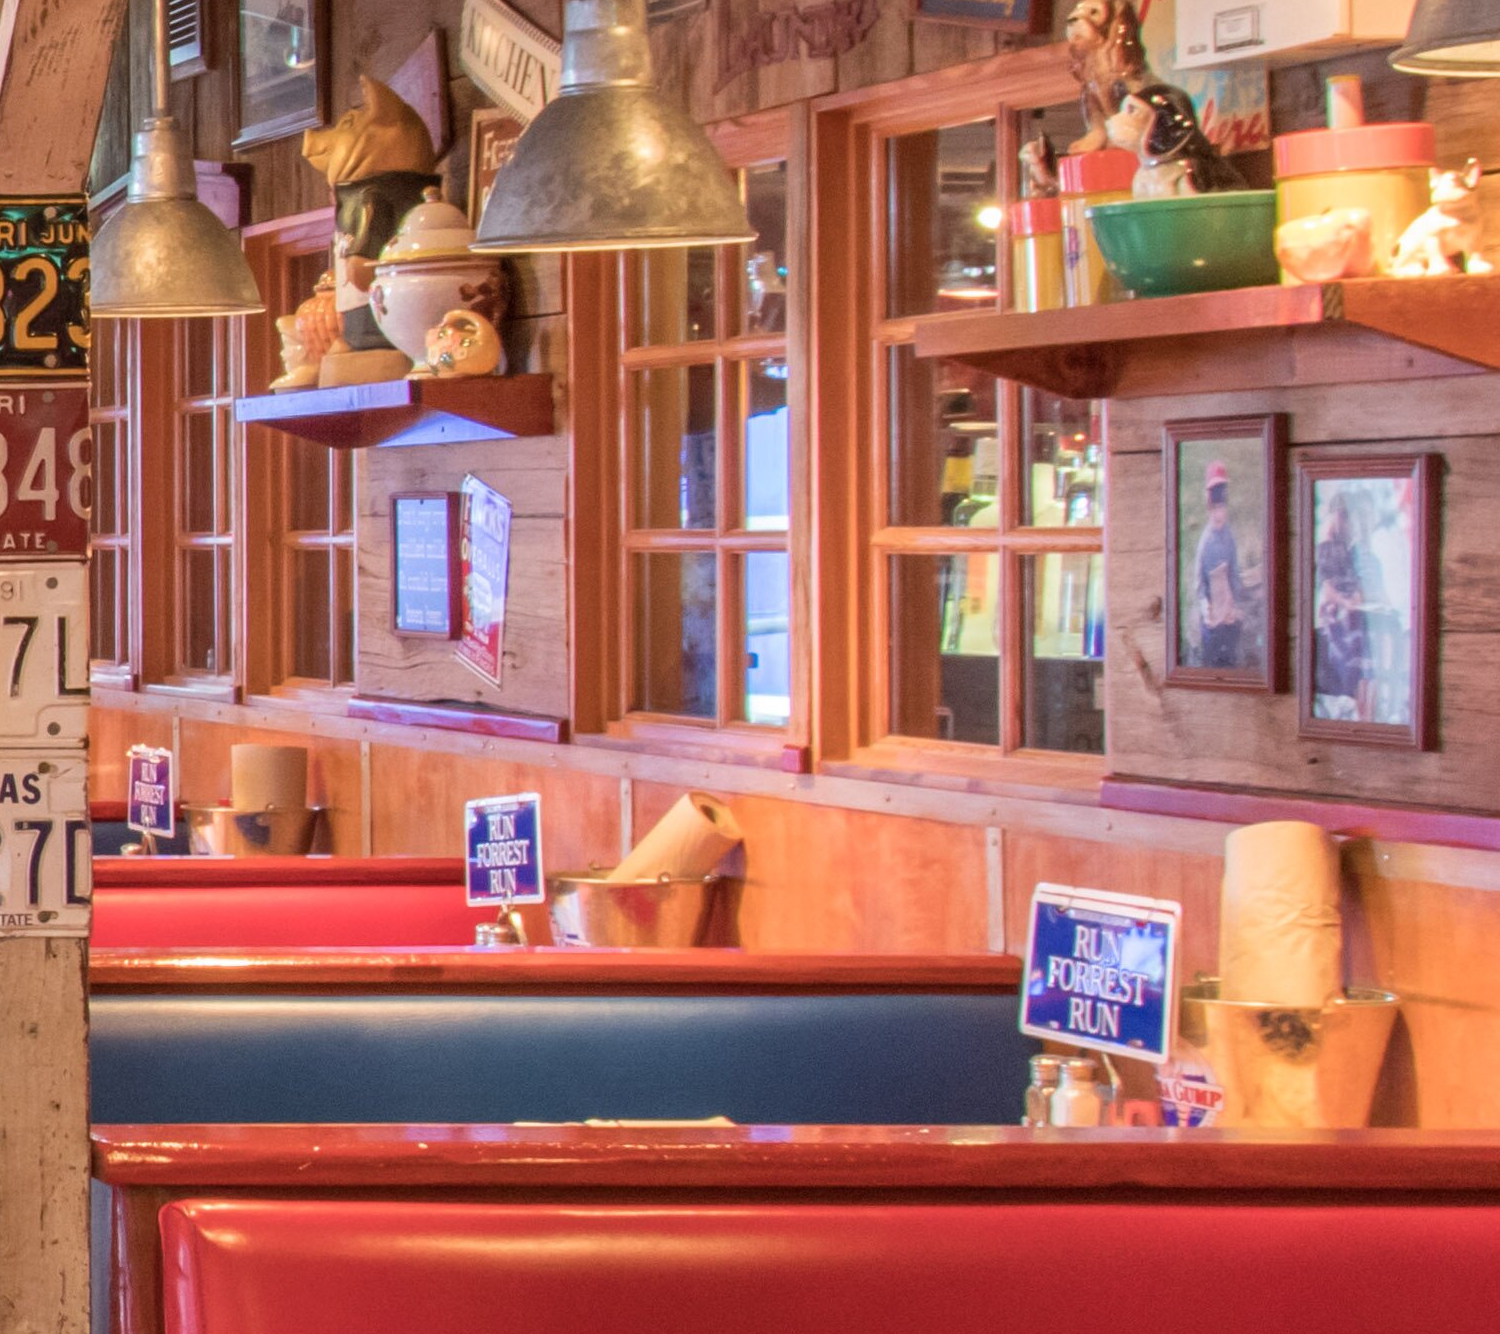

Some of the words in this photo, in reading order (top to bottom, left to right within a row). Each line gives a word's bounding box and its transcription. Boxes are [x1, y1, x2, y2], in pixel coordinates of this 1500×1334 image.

[490, 815, 516, 840] RUN
[477, 840, 529, 867] FORREST
[490, 869, 516, 895] RUN
[1074, 925, 1122, 961] RUN
[1047, 955, 1148, 1006] FORREST
[1068, 998, 1121, 1038] RUN
